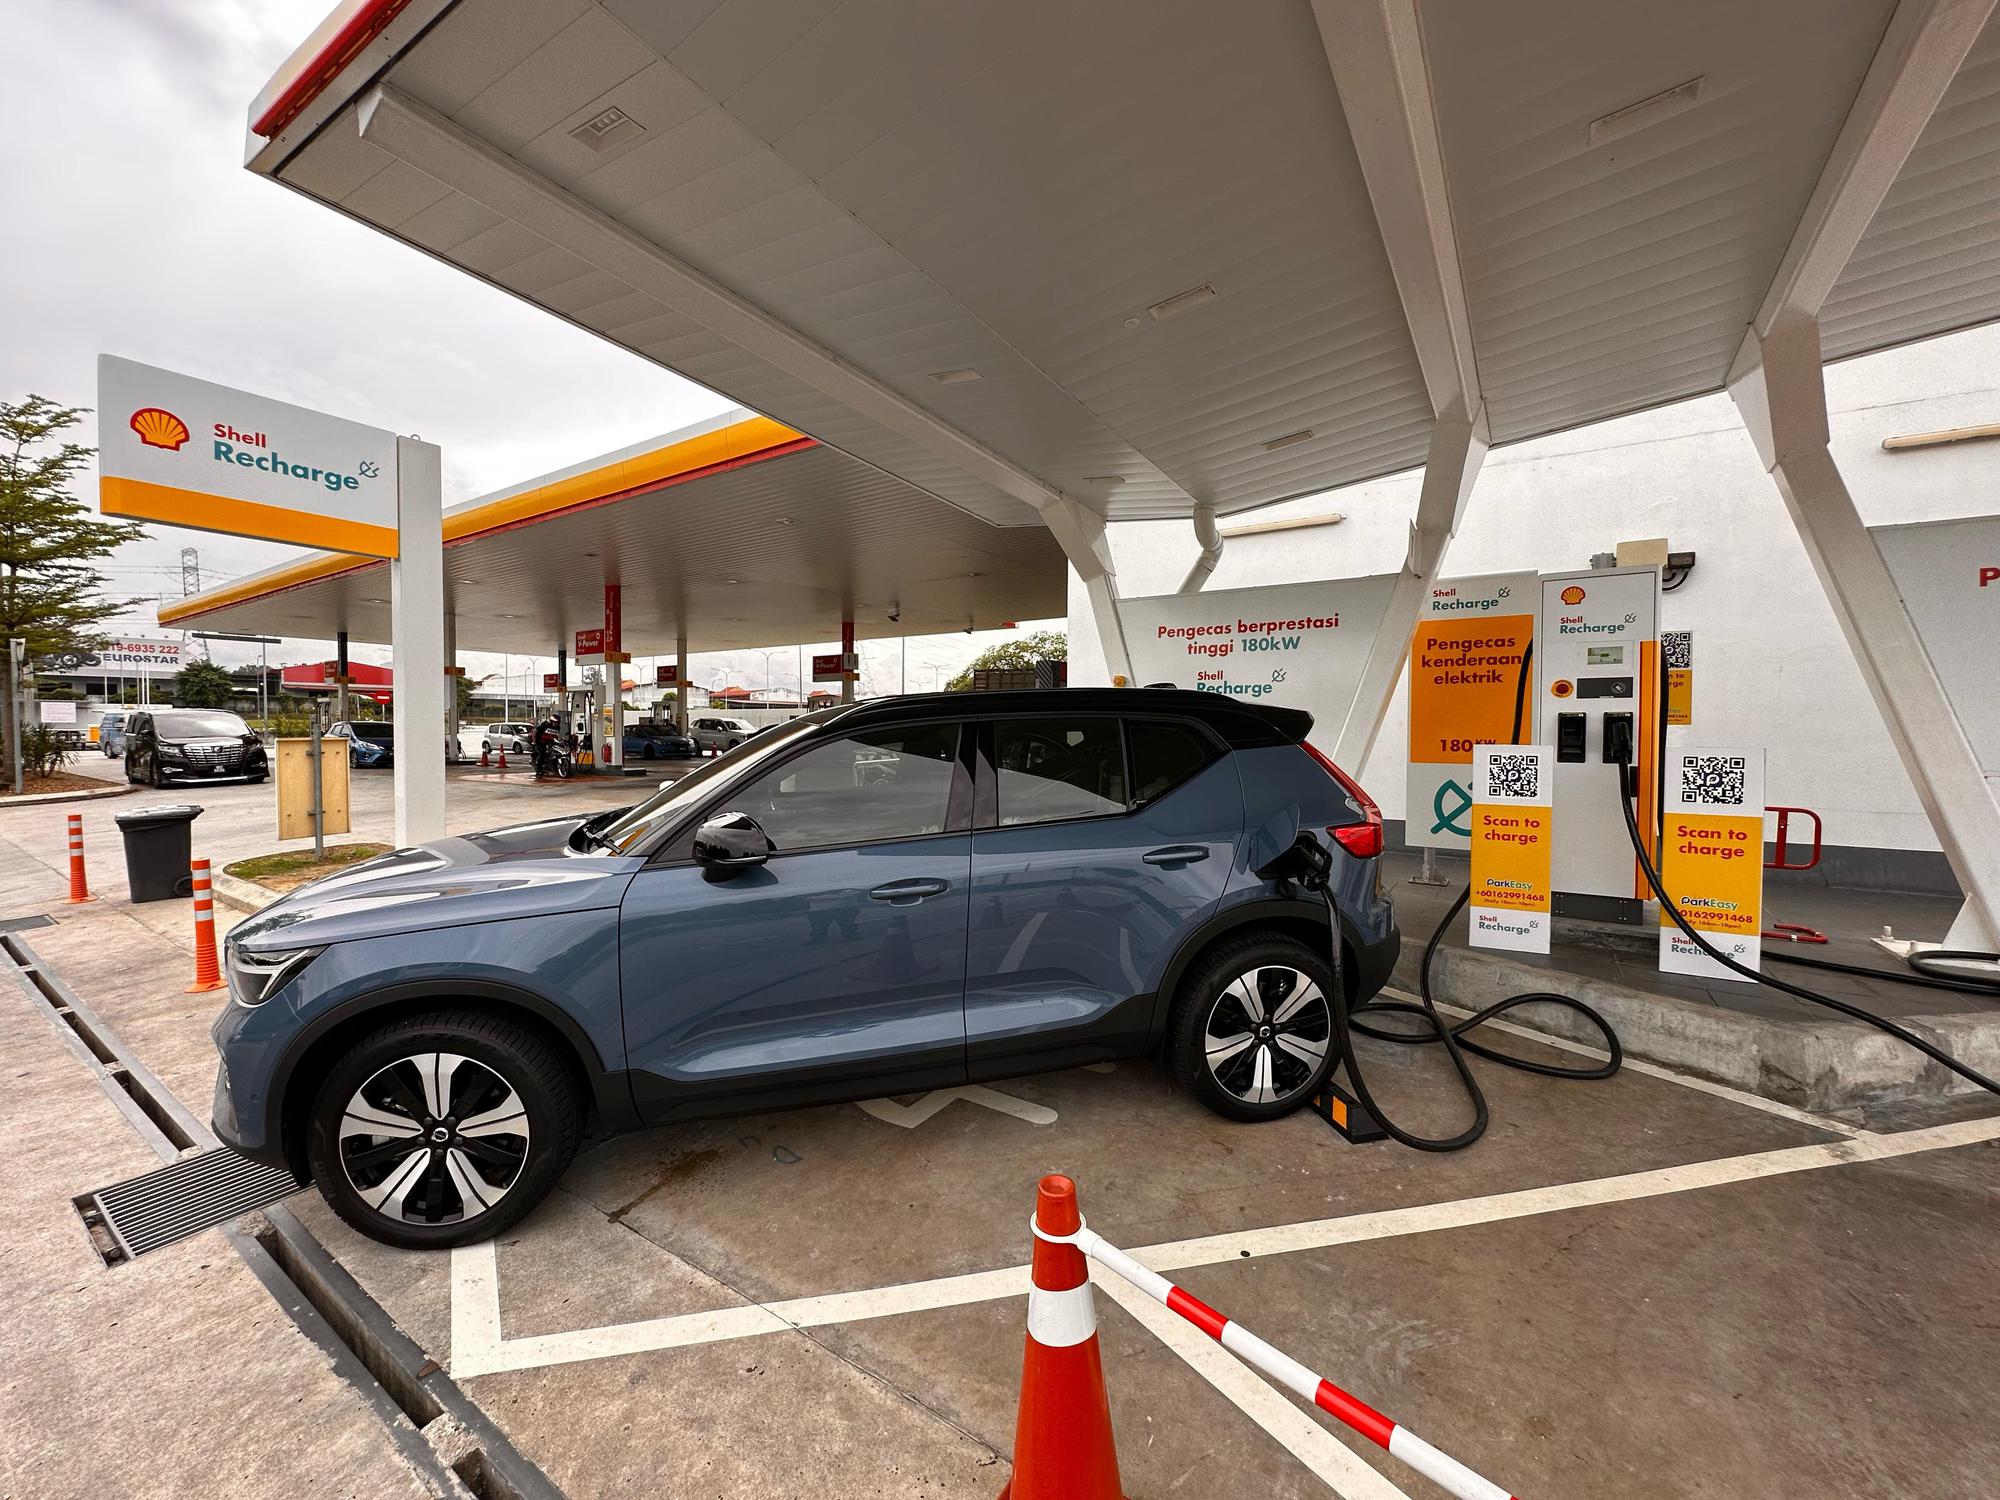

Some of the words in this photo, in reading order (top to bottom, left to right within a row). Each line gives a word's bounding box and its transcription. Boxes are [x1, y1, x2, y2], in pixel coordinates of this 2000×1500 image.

[214, 423, 266, 448] Shell
[214, 440, 359, 491] Recharge
[1433, 588, 1456, 598] Shell
[1432, 598, 1499, 611] Recharge
[1157, 622, 1232, 640] Pengecas
[1237, 613, 1339, 635] berprestasi
[1560, 616, 1583, 624] Shell
[1560, 623, 1625, 634] Recharge
[111, 643, 156, 653] 19-6935
[159, 645, 179, 655] 222
[1187, 639, 1234, 657] tinggi
[1241, 635, 1301, 652] 180kW
[1427, 637, 1516, 652] Pengecas
[103, 653, 179, 664] EUROSTAR
[1421, 653, 1522, 668] kenderaan
[1197, 670, 1223, 681] Shell
[1433, 670, 1503, 685] elektrik
[1197, 681, 1272, 697] Recharge
[1483, 815, 1519, 827] Scan
[1524, 817, 1540, 828] to
[1485, 829, 1538, 845] charge
[1677, 825, 1721, 840] Scan
[1728, 829, 1748, 841] to
[1679, 841, 1745, 860] charge
[1486, 879, 1532, 891] ParkEasy
[1475, 890, 1545, 902] +60162991468
[1681, 896, 1738, 911] ParkEasy
[1678, 909, 1753, 923] 0162991468
[1479, 921, 1530, 935] Recharge
[1671, 944, 1735, 959] Reche
